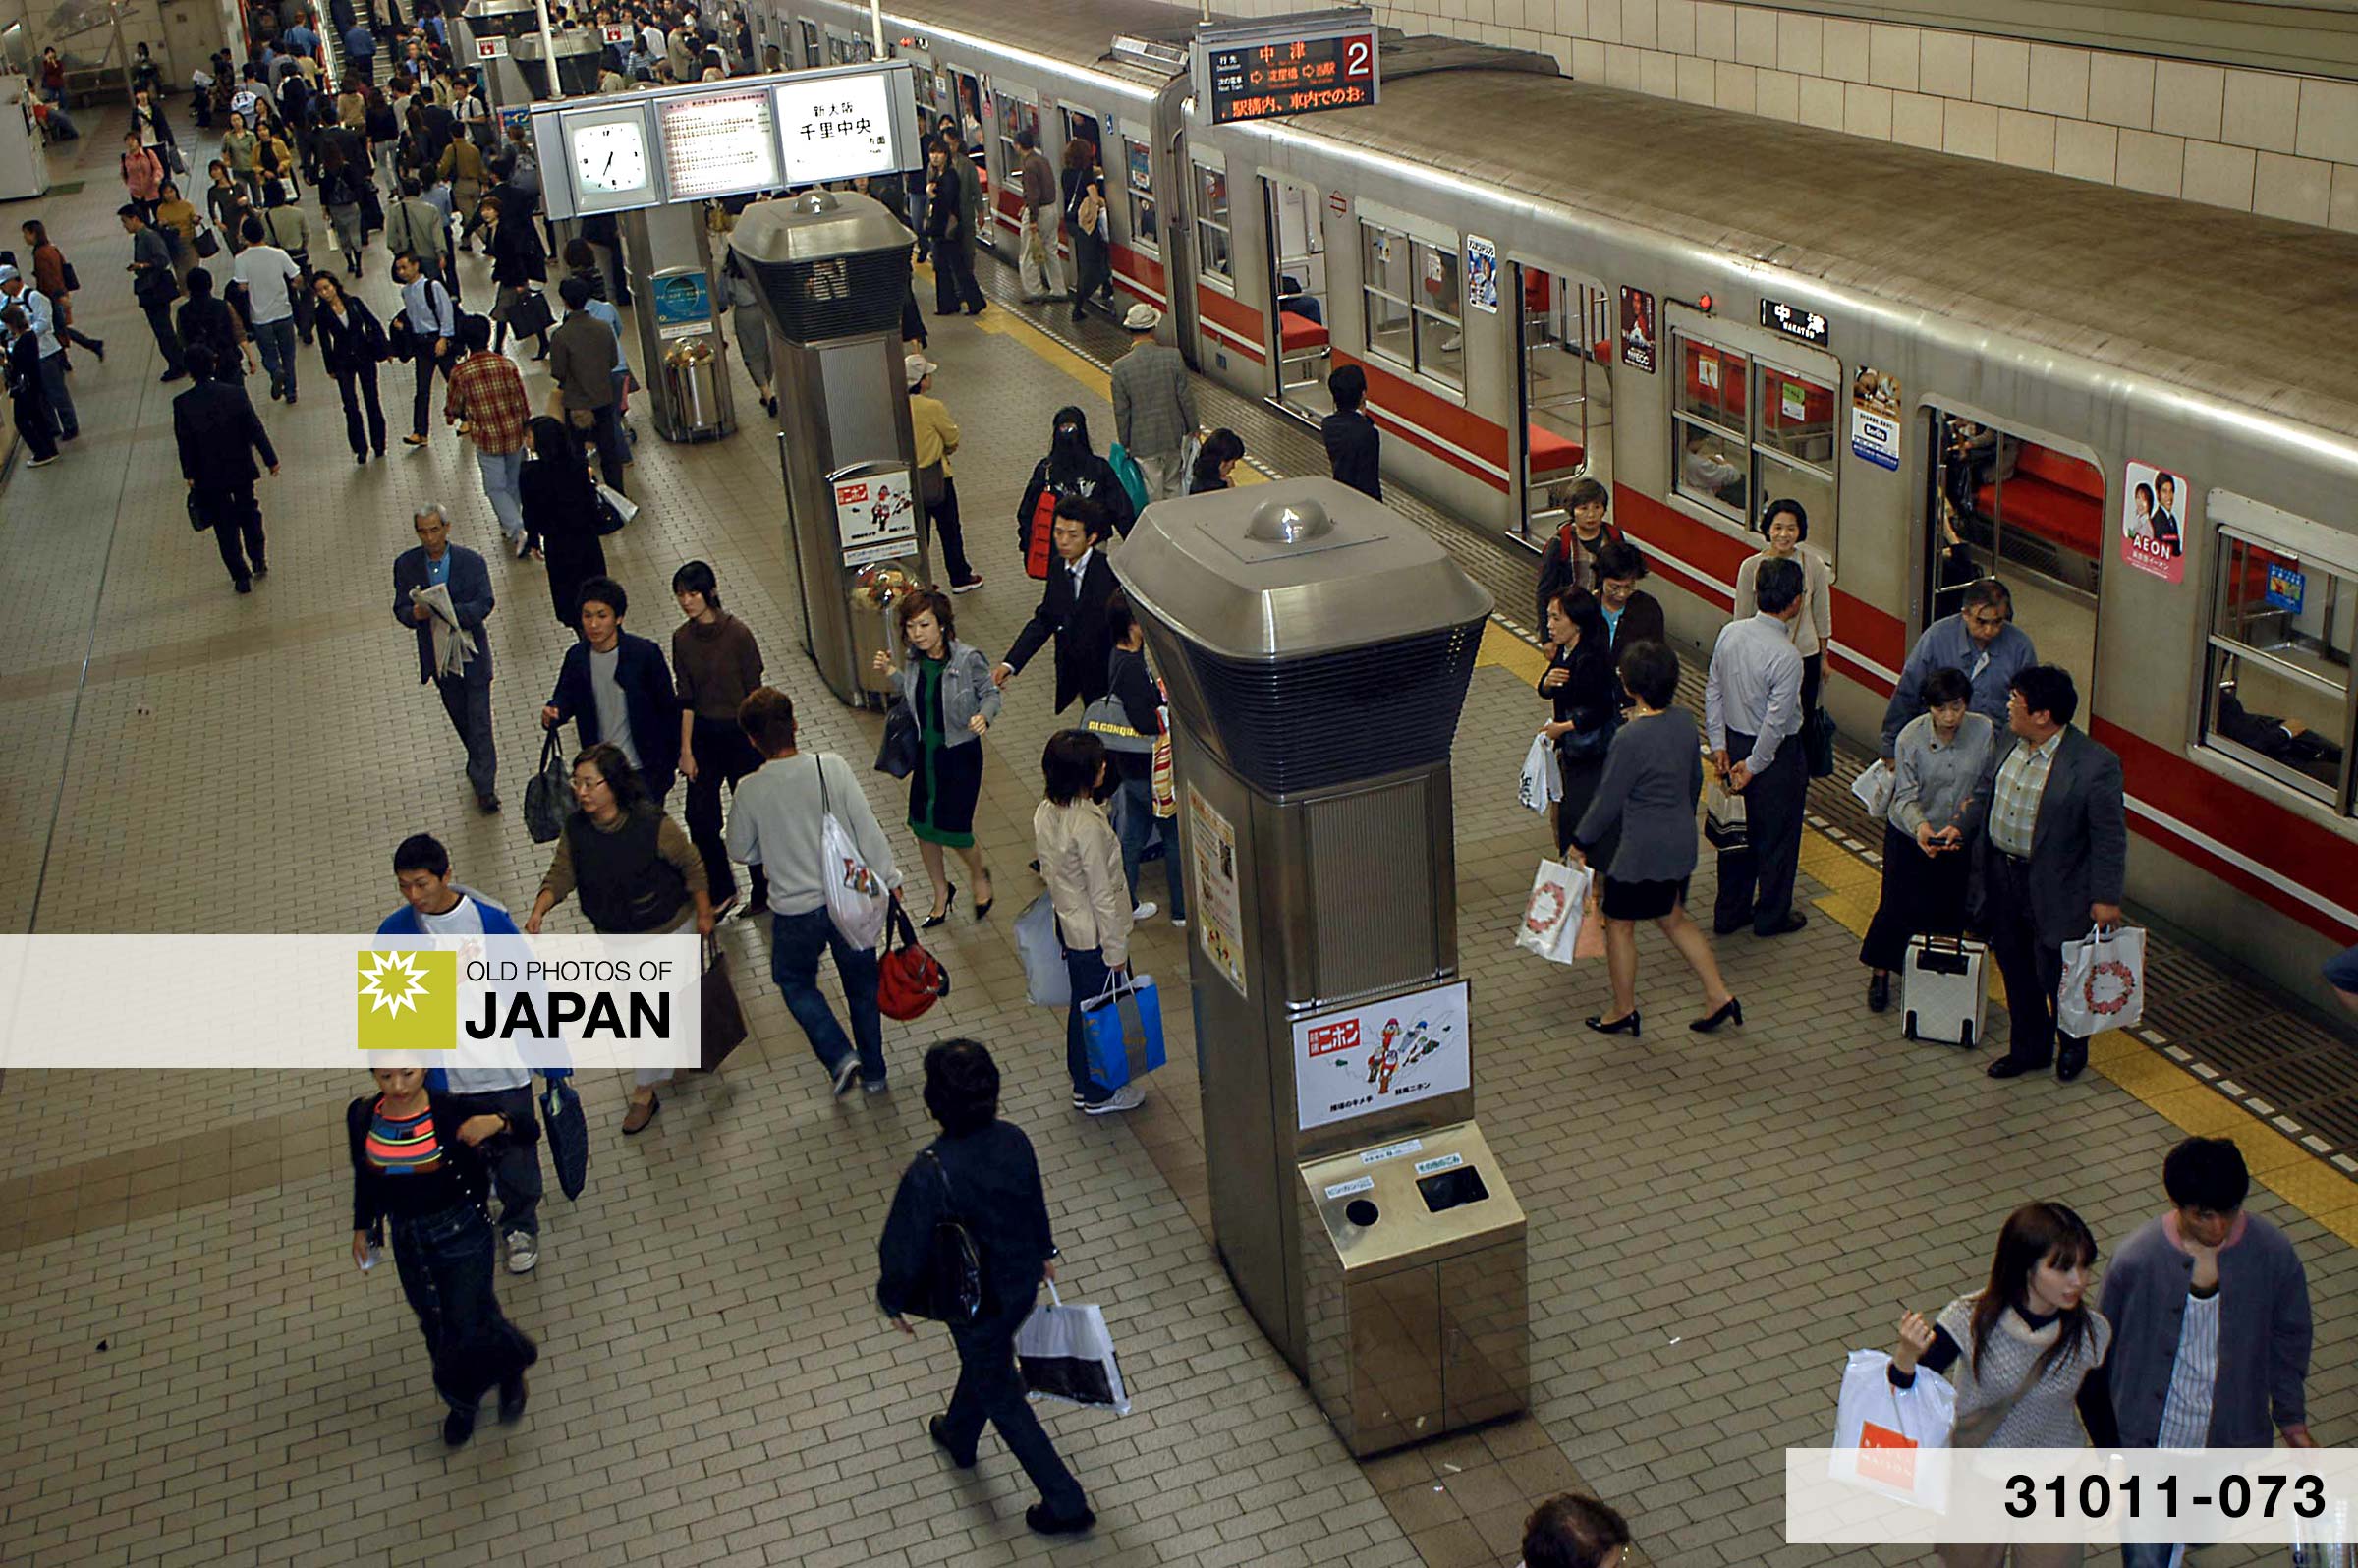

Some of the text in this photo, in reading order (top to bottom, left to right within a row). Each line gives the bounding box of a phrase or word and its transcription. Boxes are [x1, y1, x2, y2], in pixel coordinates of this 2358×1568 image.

[1347, 42, 1369, 77] 2
[814, 102, 853, 117] 新大阪
[800, 117, 871, 140] 千里中央
[1783, 321, 1816, 339] NAKATSU
[2133, 534, 2171, 561] AEON
[1319, 1024, 1359, 1052] ニホン
